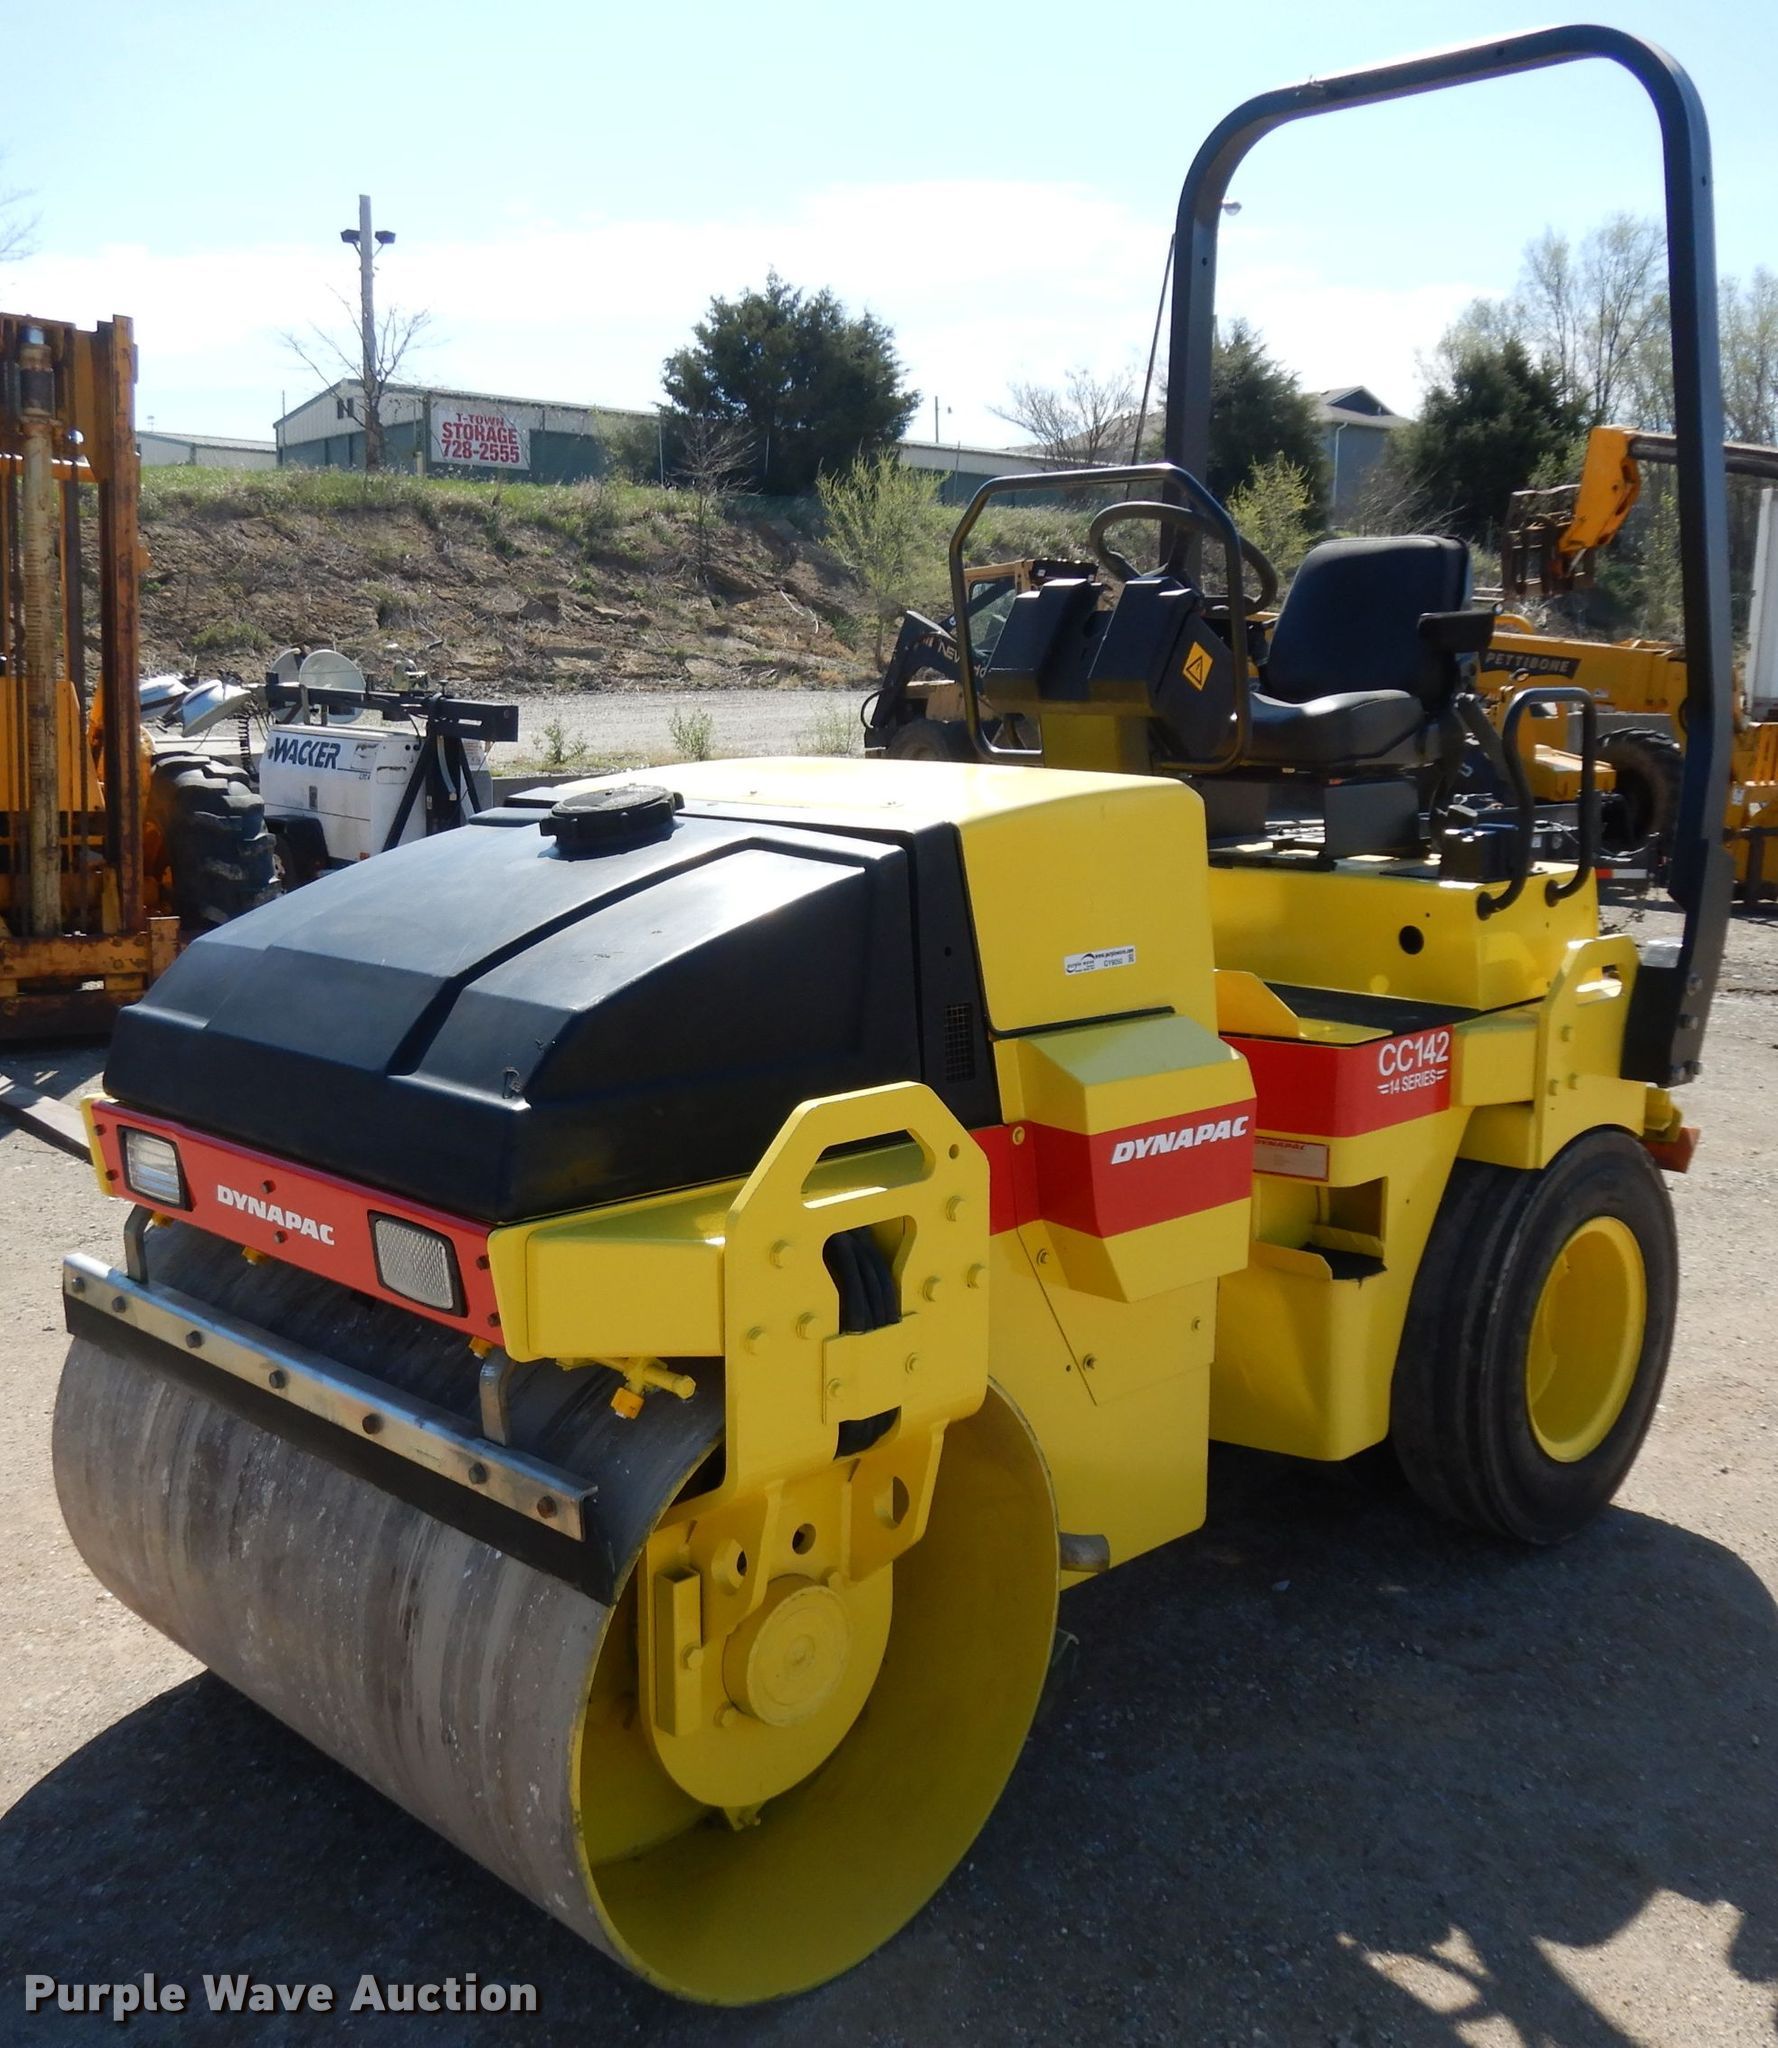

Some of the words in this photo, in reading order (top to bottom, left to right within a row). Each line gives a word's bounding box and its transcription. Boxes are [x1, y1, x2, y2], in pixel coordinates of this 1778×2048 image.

[455, 412, 505, 427] T-TOWN
[442, 422, 518, 445] STORAGE
[441, 439, 520, 464] 728-2555
[1485, 651, 1570, 673] PETTIBONE
[272, 736, 342, 770] WACKER
[1378, 1030, 1450, 1077] CC142
[1389, 1078, 1400, 1095] 14
[1401, 1068, 1437, 1092] SERIES
[1111, 1115, 1249, 1165] DYNAPAC
[217, 1184, 335, 1246] DYNAPAC
